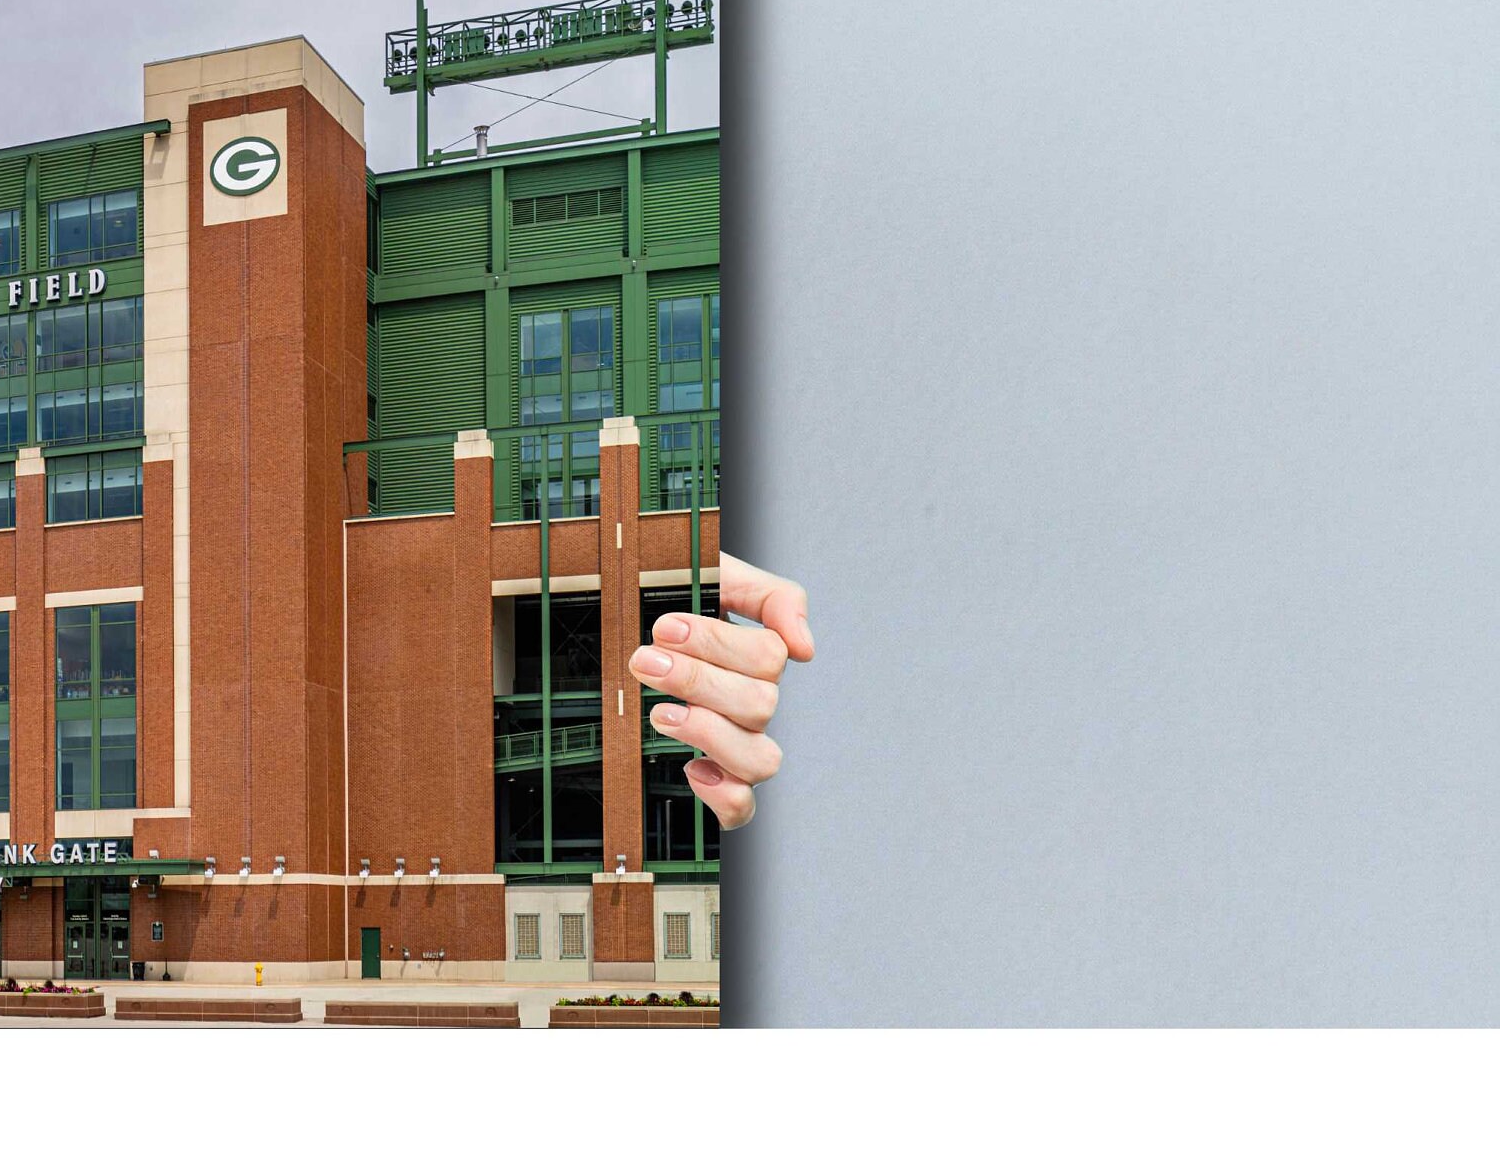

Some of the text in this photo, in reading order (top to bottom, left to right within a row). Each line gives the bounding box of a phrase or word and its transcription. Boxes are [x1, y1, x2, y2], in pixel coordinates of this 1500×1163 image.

[212, 139, 278, 194] G
[9, 268, 106, 307] FIELD
[50, 841, 117, 864] GATE
